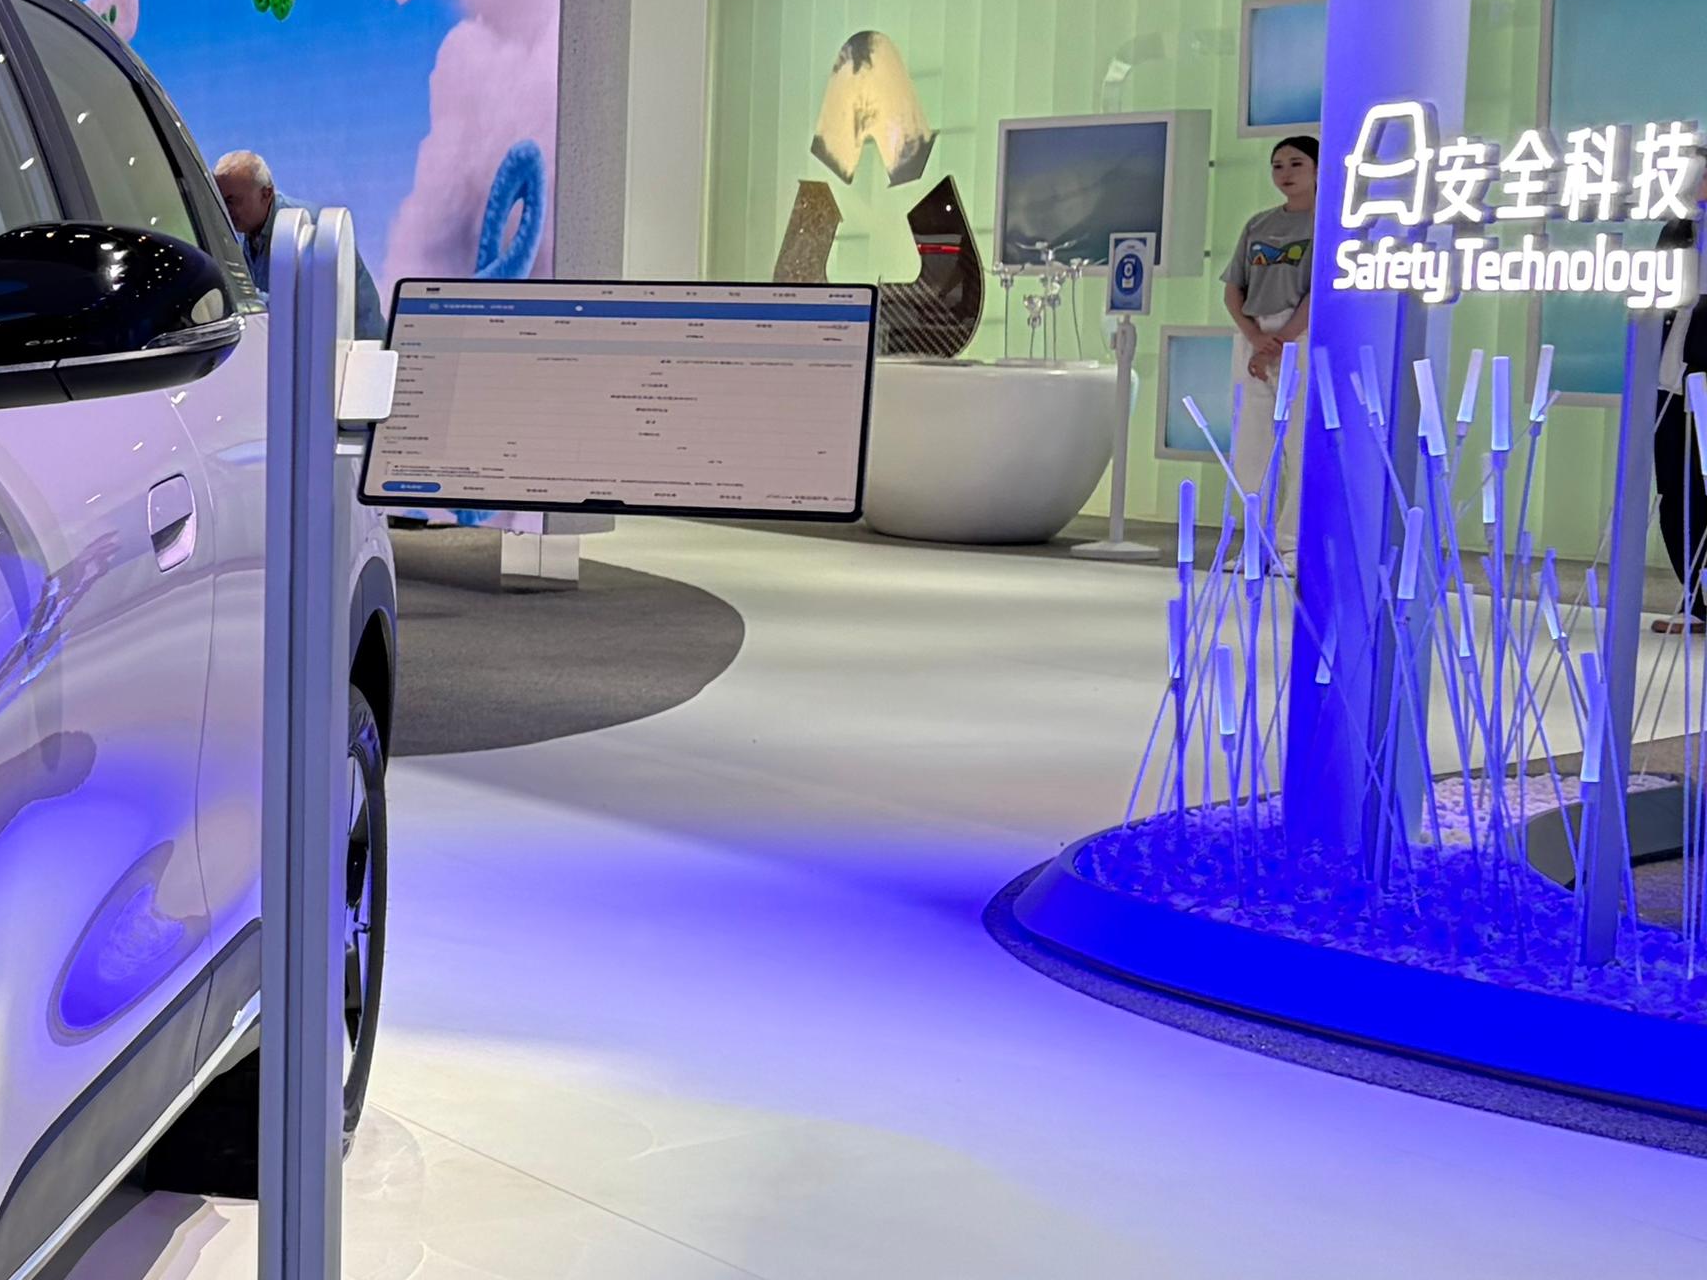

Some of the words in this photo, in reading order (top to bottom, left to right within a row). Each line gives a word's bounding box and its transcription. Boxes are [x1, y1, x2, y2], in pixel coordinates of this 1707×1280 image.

[1433, 120, 1696, 223] 安全科技
[1332, 235, 1449, 304] Safety
[1454, 232, 1689, 309] Technology
